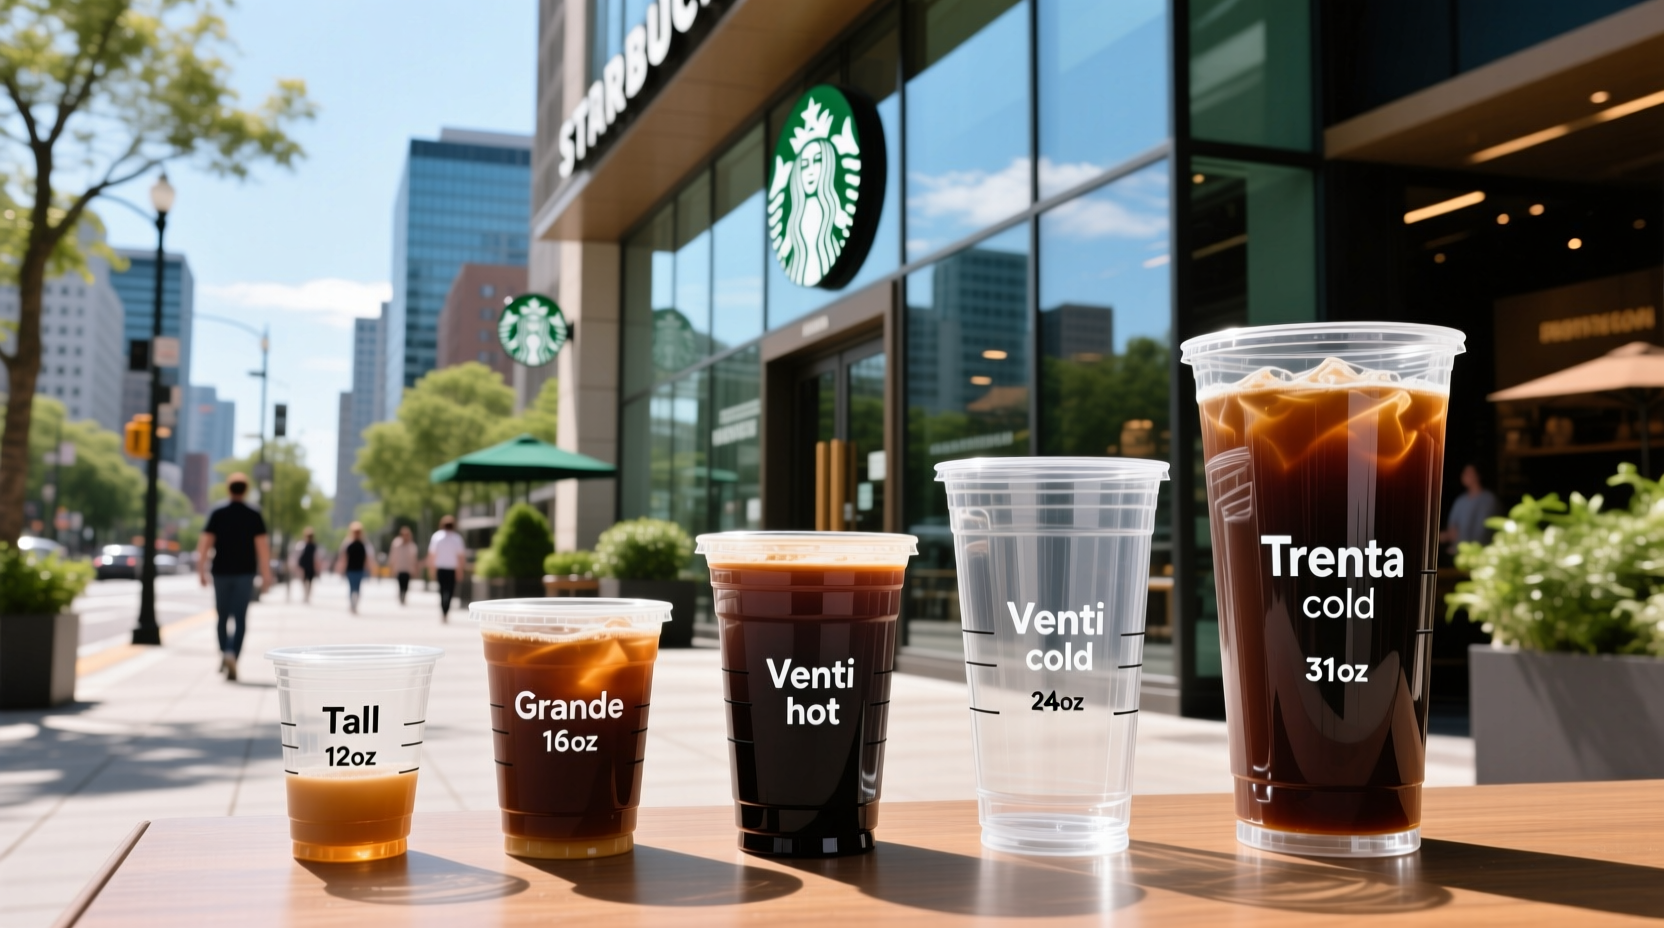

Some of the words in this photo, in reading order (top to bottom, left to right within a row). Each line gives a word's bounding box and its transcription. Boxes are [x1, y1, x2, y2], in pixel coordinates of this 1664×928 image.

[558, 0, 711, 178] STARBU
[1260, 535, 1404, 578] Trenta
[1006, 601, 1105, 636] Venti
[1302, 587, 1375, 619] cold
[1025, 641, 1094, 672] cold
[1305, 657, 1369, 683] 31oz
[766, 657, 855, 689] Venti
[515, 690, 624, 721] Grande
[786, 696, 840, 725] hot
[1031, 690, 1085, 712] 24oz
[322, 704, 380, 735] Tall
[325, 745, 377, 767] 12oz
[543, 729, 598, 752] 16oz
